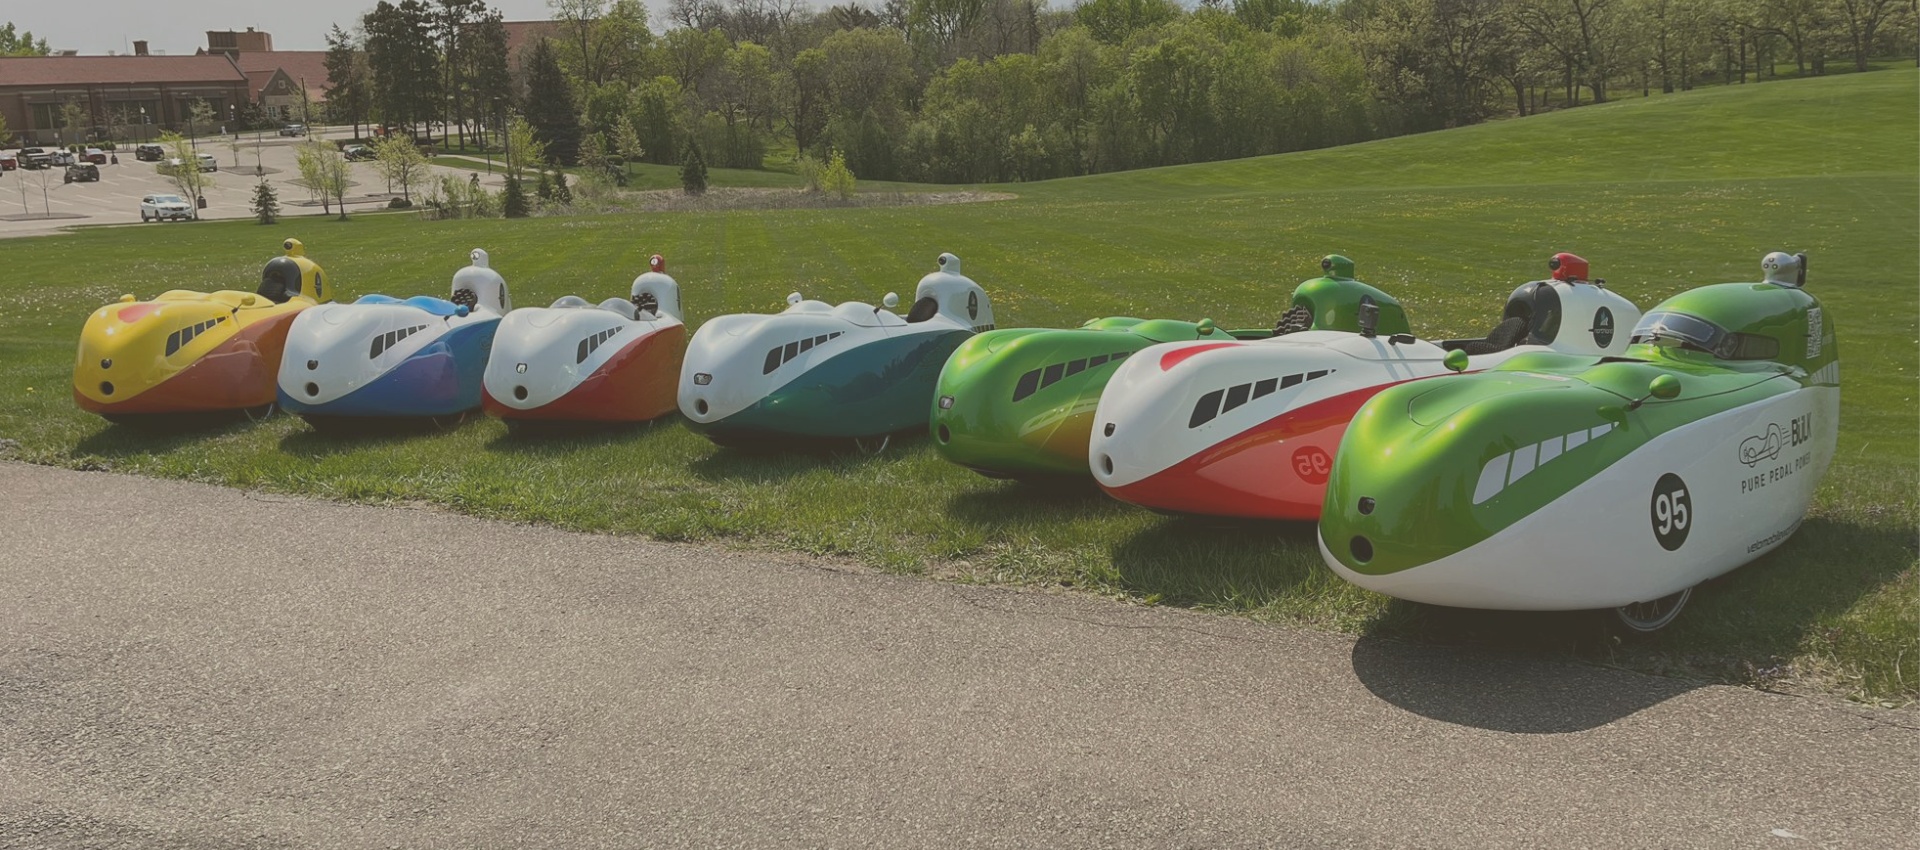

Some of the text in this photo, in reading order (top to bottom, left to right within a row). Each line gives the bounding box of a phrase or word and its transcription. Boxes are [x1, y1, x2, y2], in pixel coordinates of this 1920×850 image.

[1741, 452, 1811, 494] PURE PEDAL POWER
[1655, 489, 1688, 536] 95
